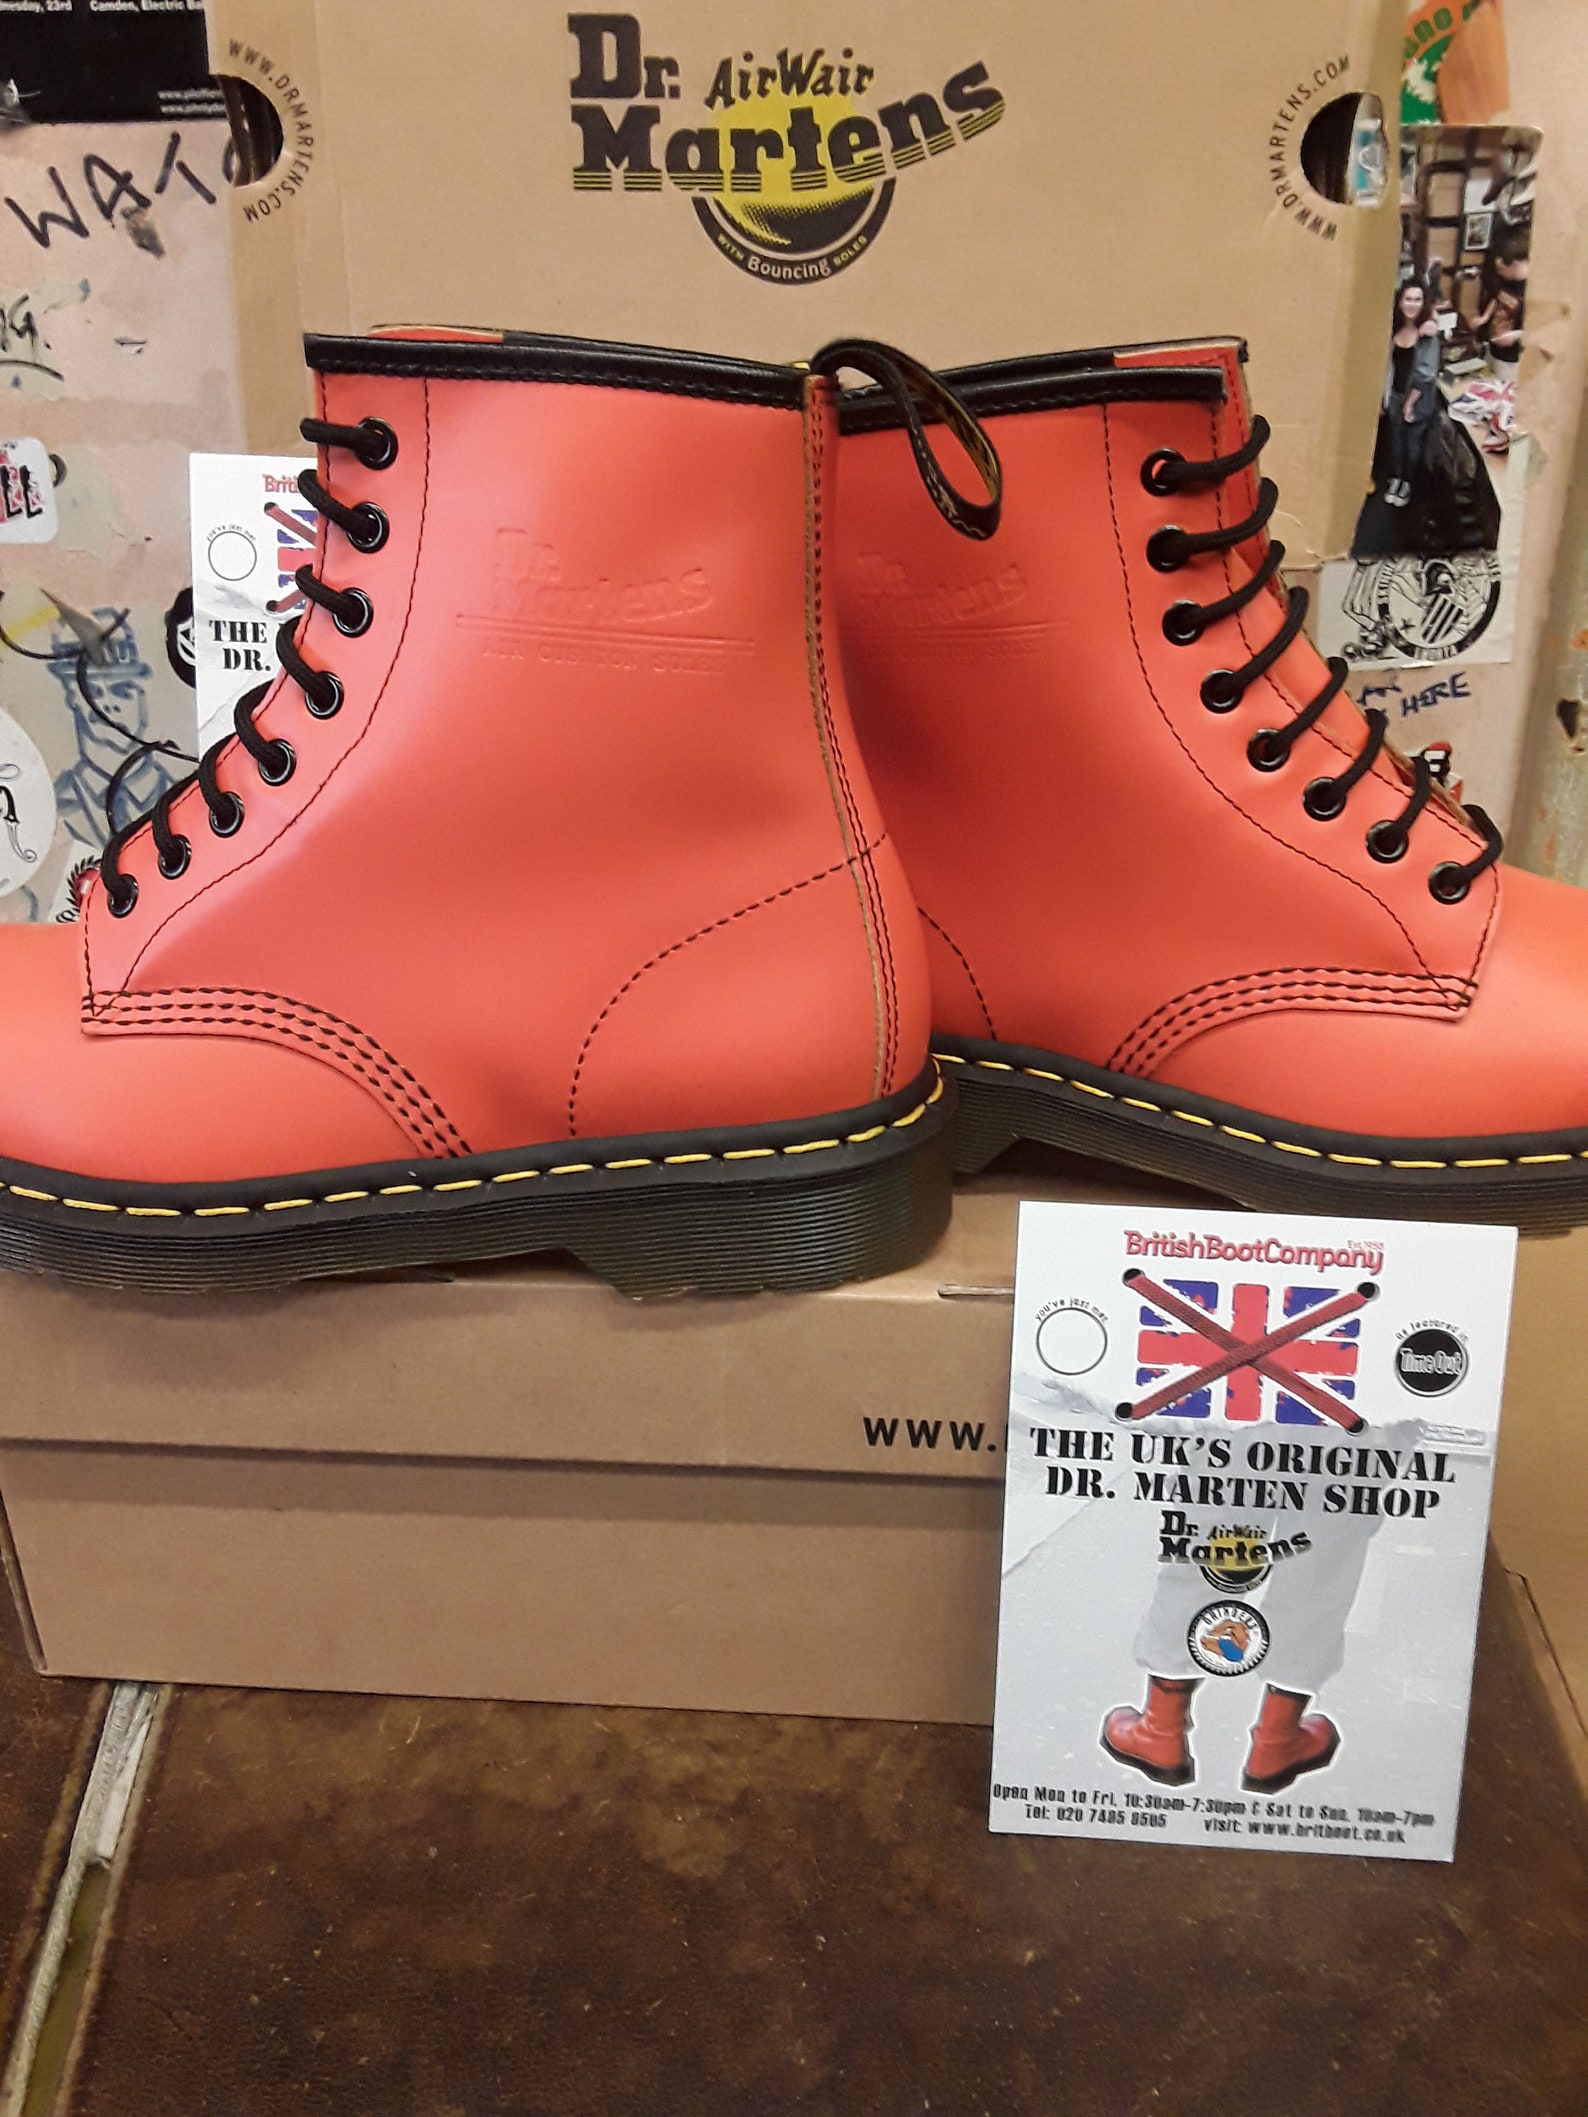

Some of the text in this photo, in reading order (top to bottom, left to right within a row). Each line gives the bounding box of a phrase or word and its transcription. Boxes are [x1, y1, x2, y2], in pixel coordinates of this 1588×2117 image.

[567, 12, 681, 99] Dr.
[704, 47, 875, 110] AirWair
[229, 38, 315, 223] WWW.DRMARTENS.COM
[570, 60, 1006, 192] Martens
[747, 256, 832, 279] Bouncing
[208, 620, 268, 644] THE
[222, 647, 271, 672] DR.
[863, 1417, 1008, 1453] WWW.
[1030, 1427, 1455, 1483] THE UK'S ORIGINAL
[1046, 1466, 1440, 1519] DR. MARTEN SHOP
[1161, 1510, 1199, 1537] Dr.
[1157, 1531, 1313, 1566] Martens
[993, 1783, 1028, 1800] Open
[1034, 1786, 1066, 1802] Mon
[1072, 1789, 1087, 1803] to
[1265, 1802, 1293, 1817] Sat
[1300, 1805, 1315, 1819] to
[1057, 1806, 1083, 1822] 020
